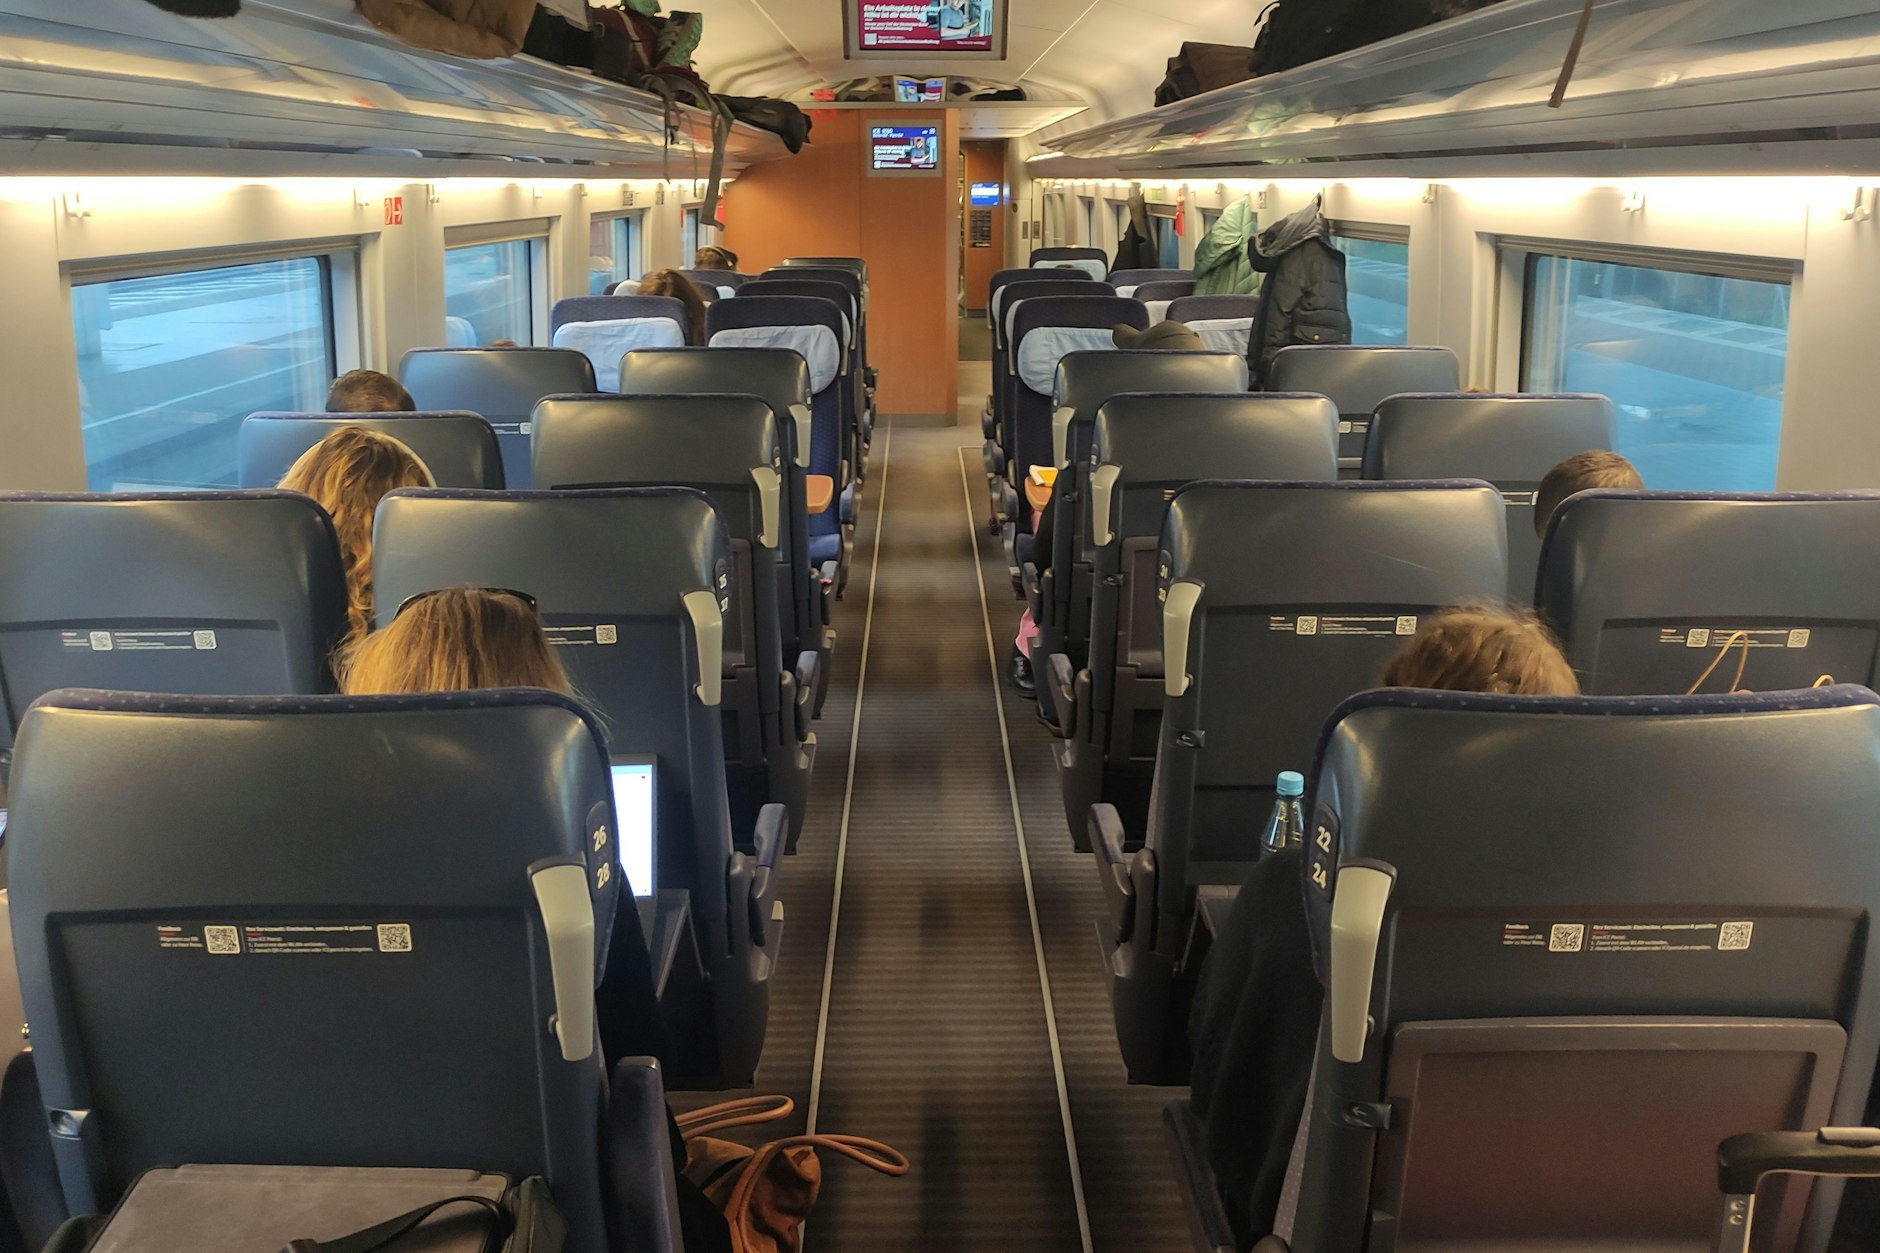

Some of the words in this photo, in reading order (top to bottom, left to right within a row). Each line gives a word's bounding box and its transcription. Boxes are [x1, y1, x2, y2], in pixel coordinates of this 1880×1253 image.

[593, 824, 607, 852] 26
[1316, 825, 1331, 853] 22
[596, 862, 611, 889] 28
[1312, 862, 1327, 889] 24
